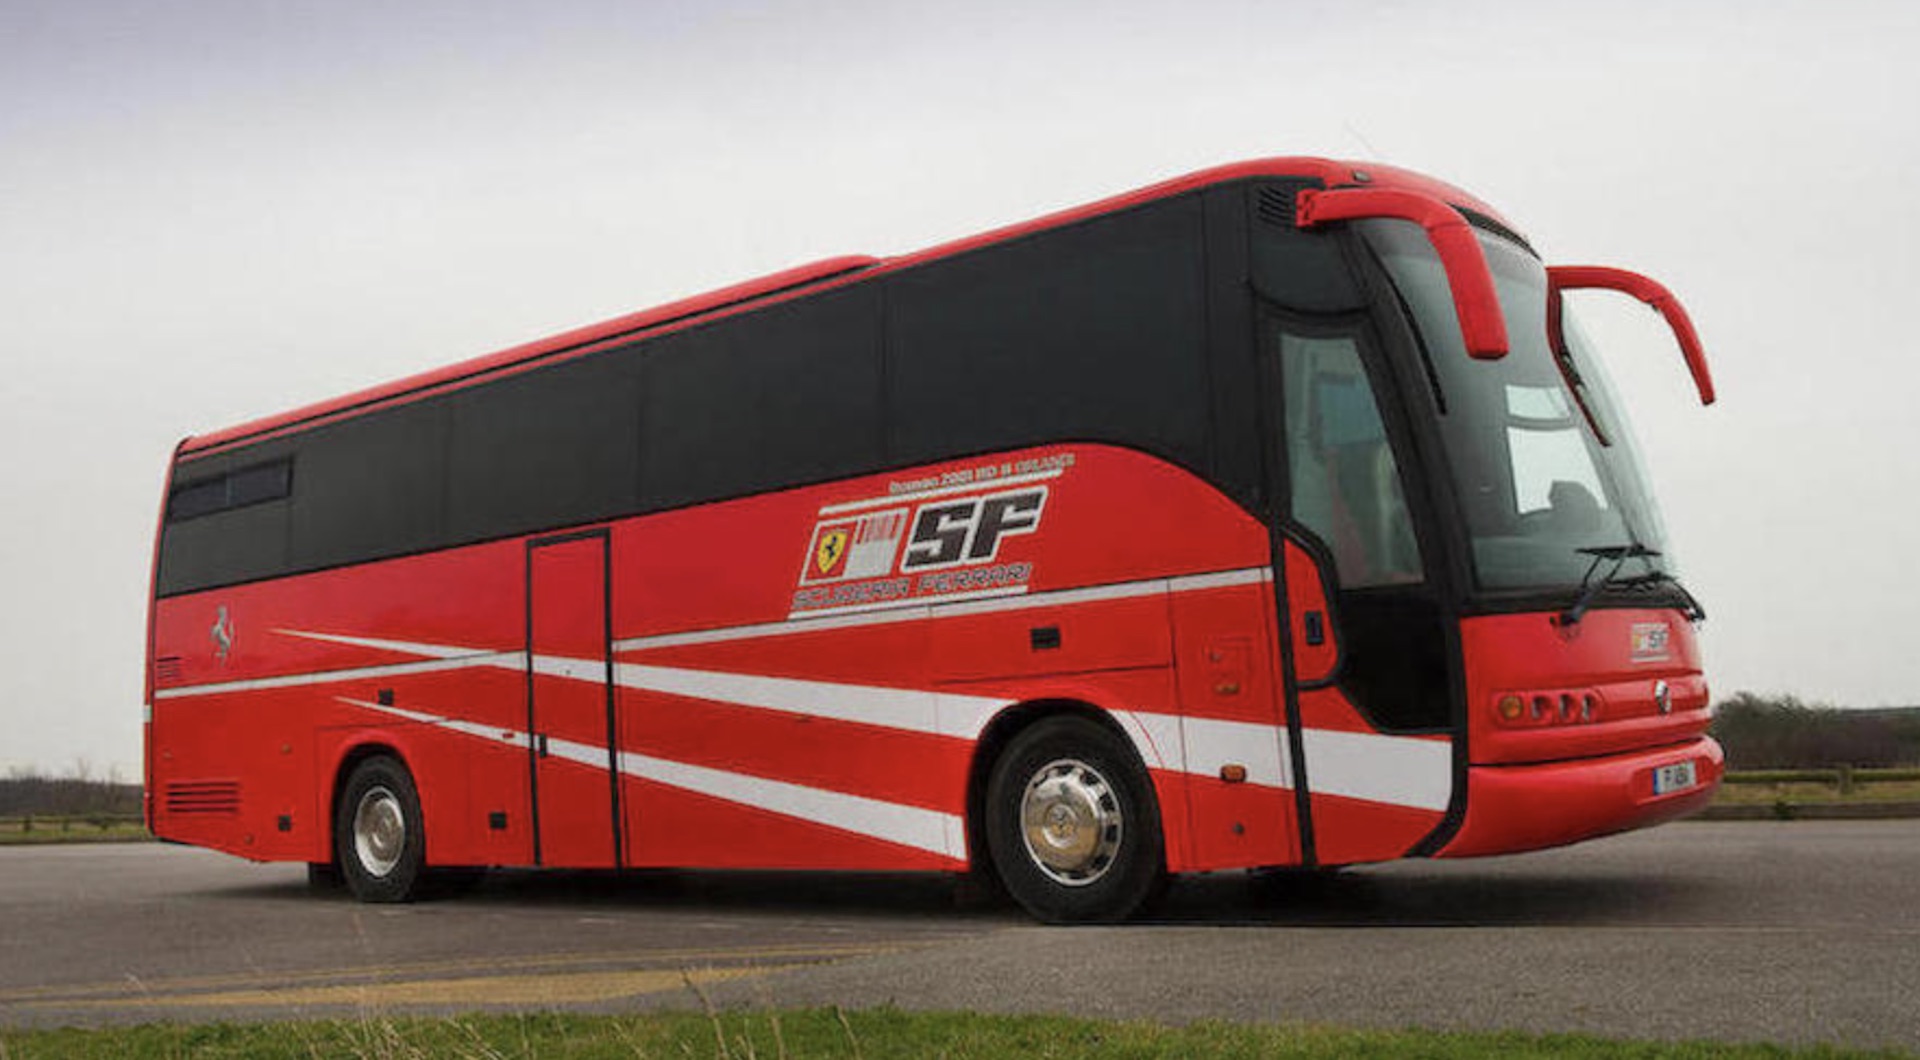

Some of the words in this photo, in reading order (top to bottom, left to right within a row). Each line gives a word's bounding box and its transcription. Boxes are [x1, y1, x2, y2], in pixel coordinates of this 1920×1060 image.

[902, 486, 1047, 572] SF
[793, 578, 909, 608] SCUDERIA
[917, 563, 1032, 592] FERRARI
